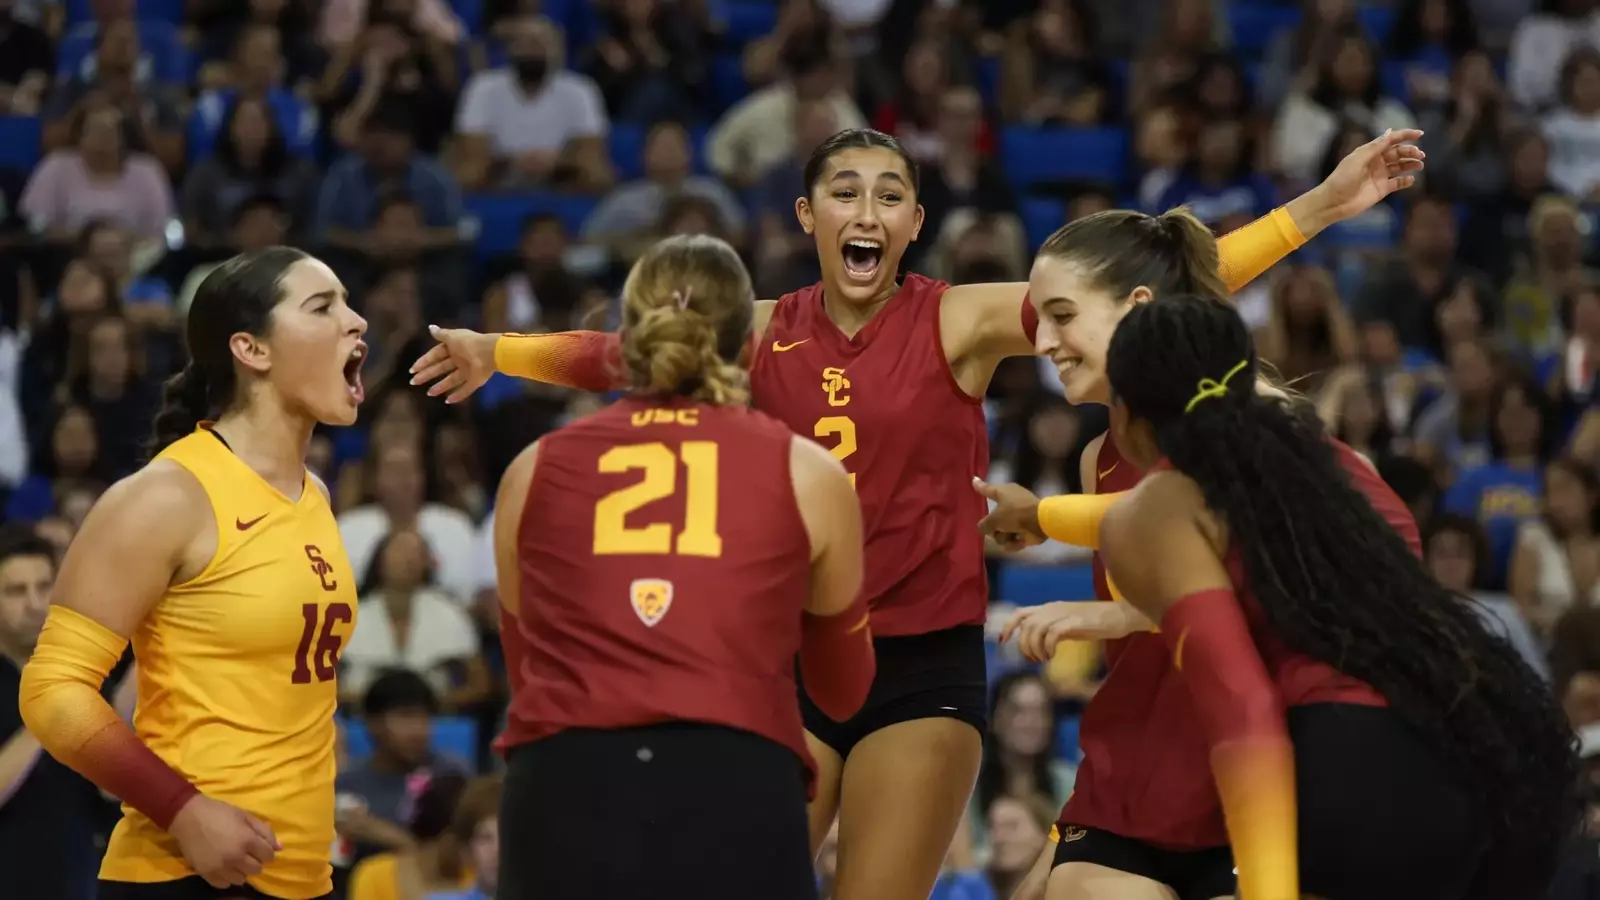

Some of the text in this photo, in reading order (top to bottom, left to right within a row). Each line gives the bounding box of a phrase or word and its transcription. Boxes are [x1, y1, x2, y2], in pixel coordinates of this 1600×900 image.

[822, 367, 851, 407] SC
[593, 441, 722, 558] 21
[304, 545, 337, 591] SC
[291, 603, 352, 684] 16
